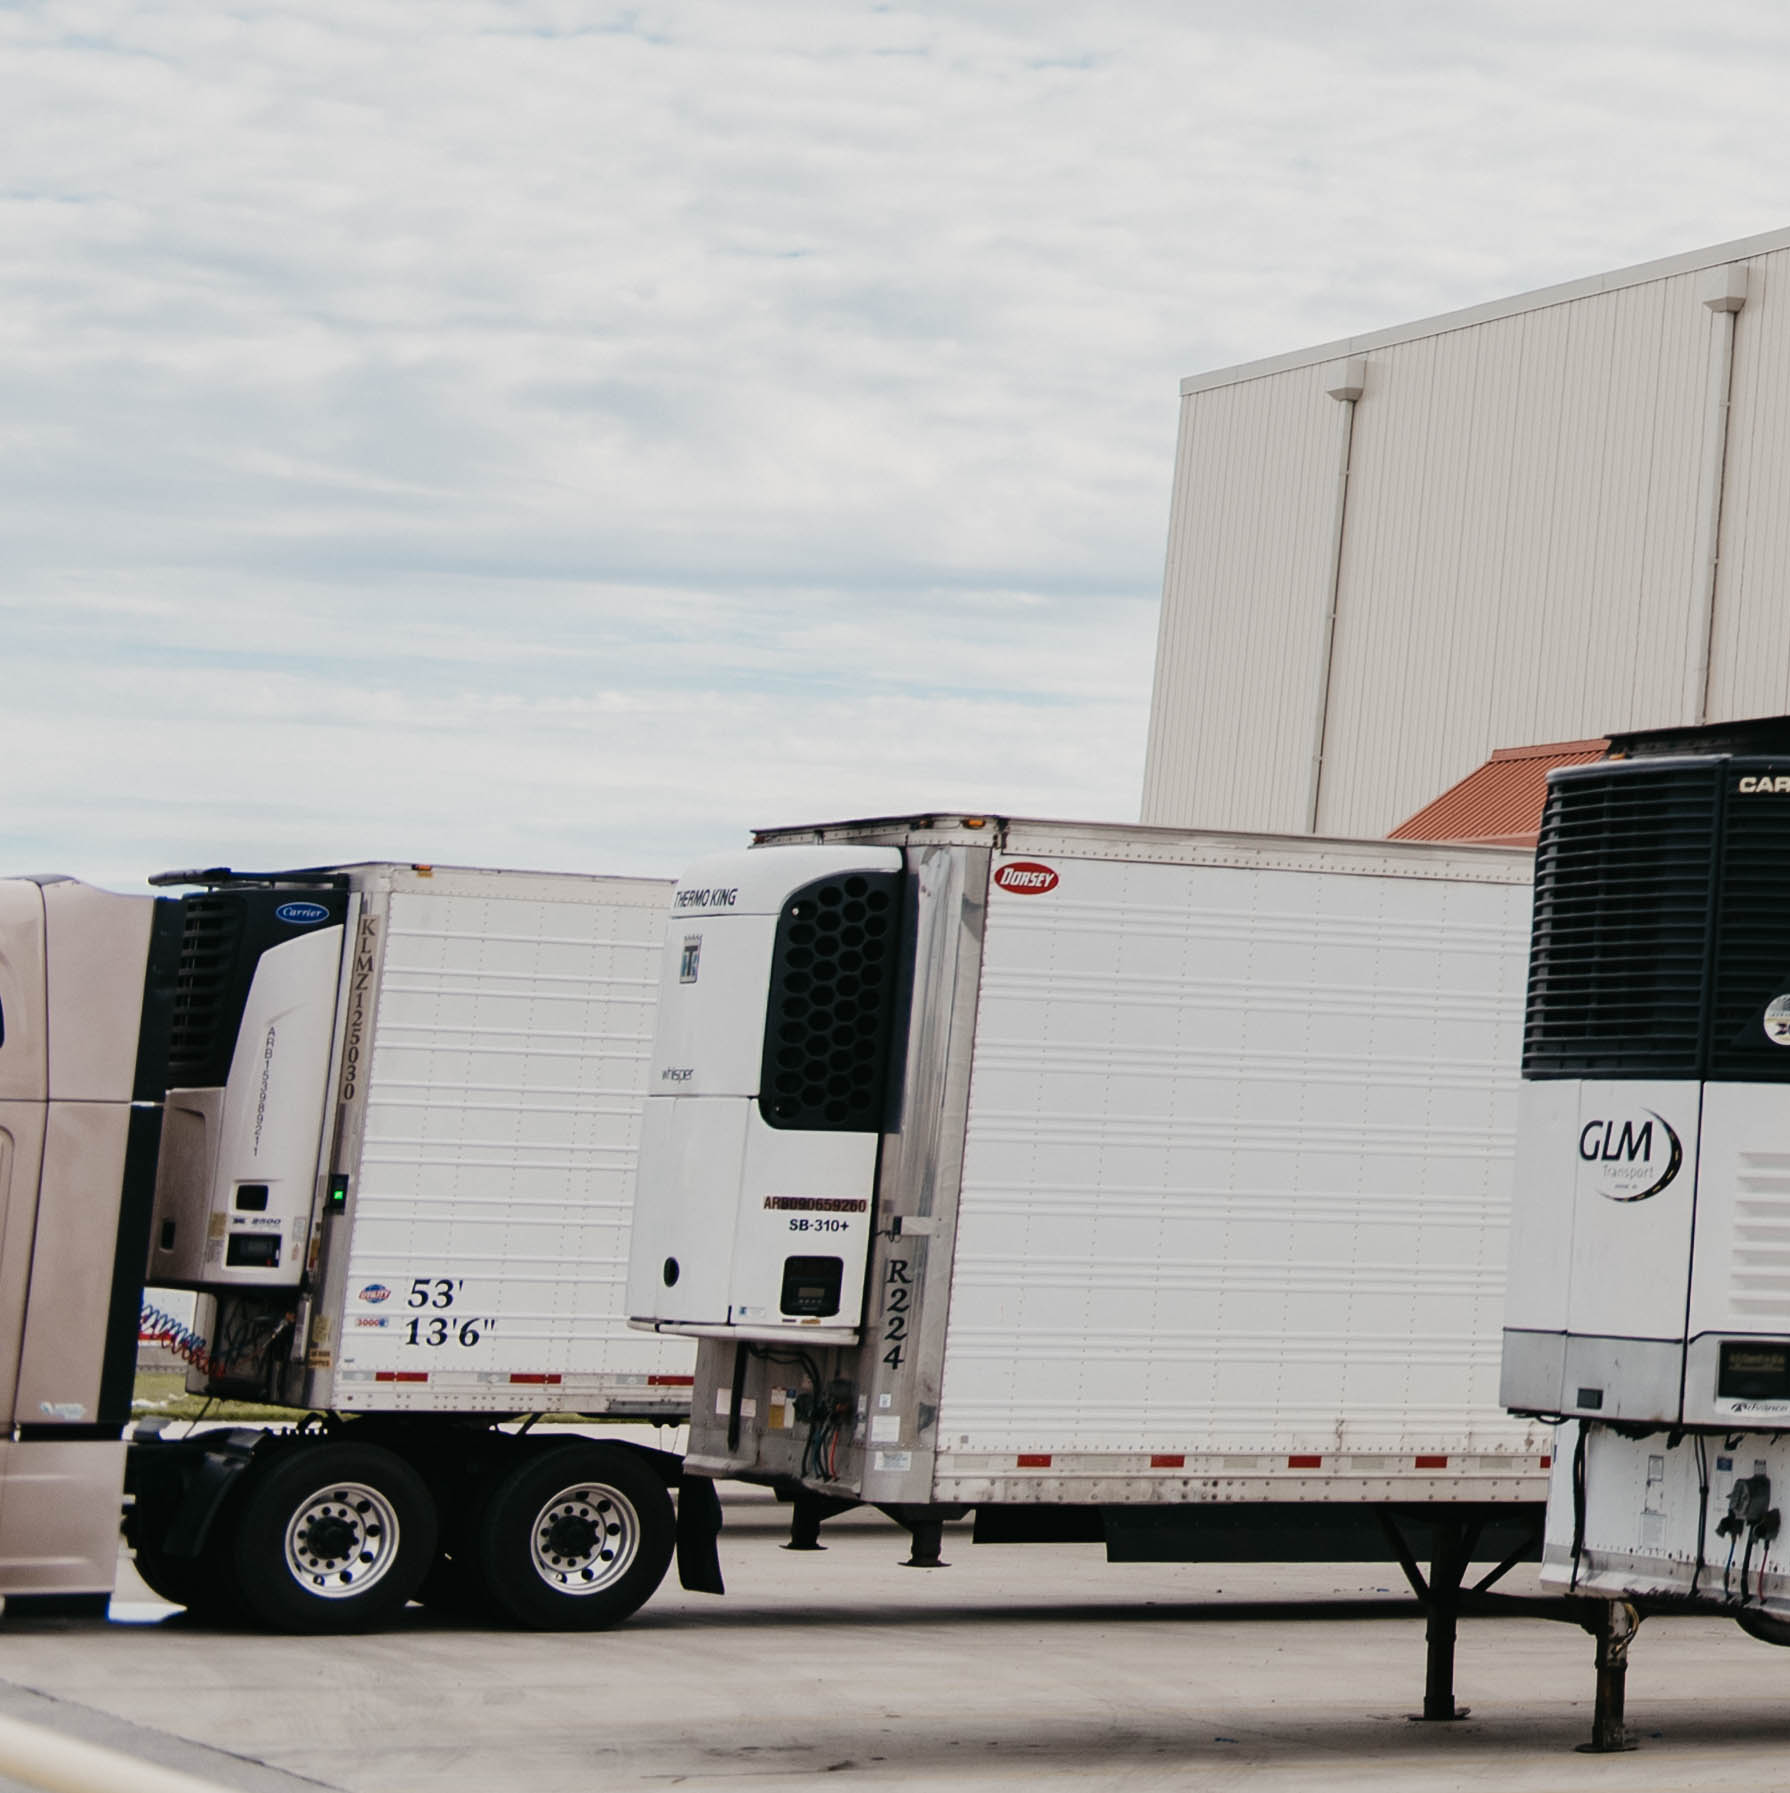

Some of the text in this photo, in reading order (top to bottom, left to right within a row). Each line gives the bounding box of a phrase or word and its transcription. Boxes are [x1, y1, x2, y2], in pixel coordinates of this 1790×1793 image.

[1000, 868, 1055, 887] DORSEY
[674, 888, 738, 907] THERMO KING
[282, 907, 323, 919] Carrier
[344, 918, 376, 1101] KLMZ125030
[1579, 1120, 1653, 1162] GLM
[1603, 1165, 1654, 1180] Transport
[788, 1219, 849, 1232] SB-310+
[407, 1279, 463, 1308] 53'
[882, 1259, 912, 1370] R224
